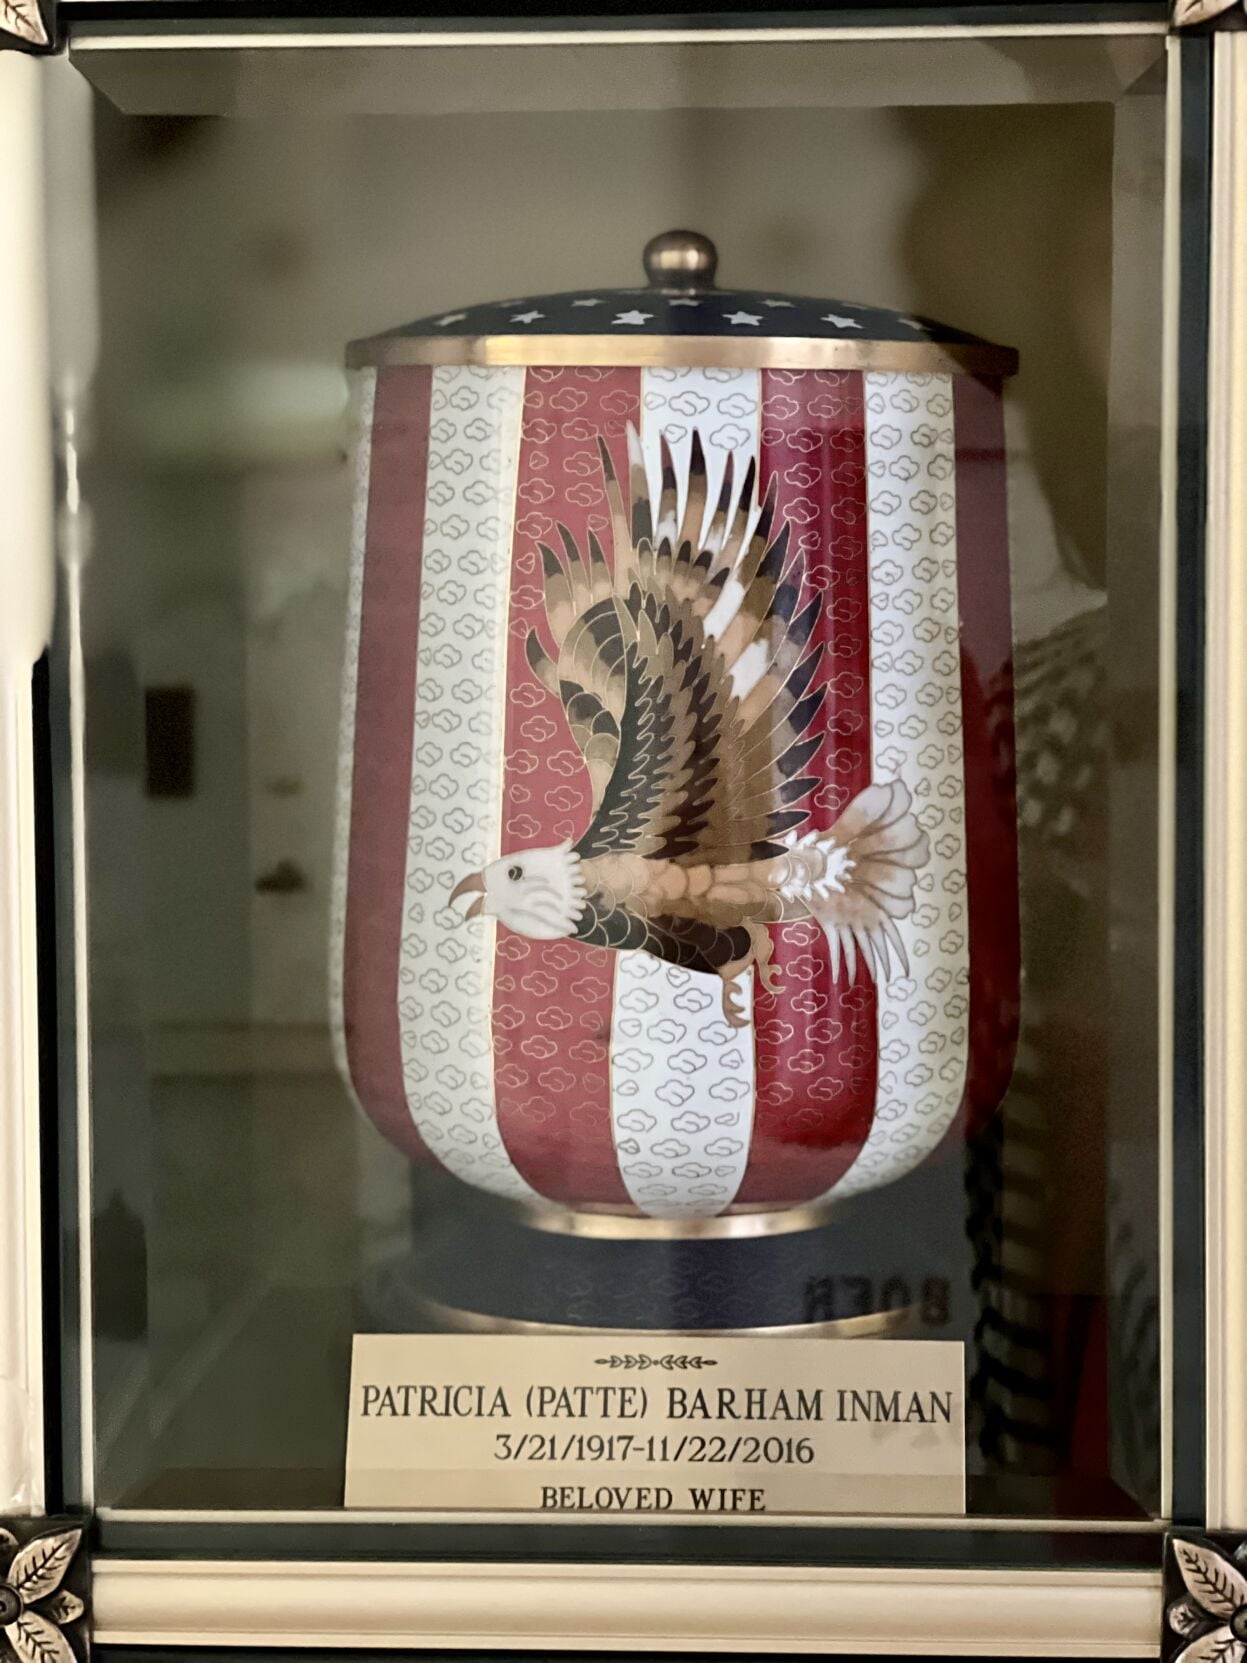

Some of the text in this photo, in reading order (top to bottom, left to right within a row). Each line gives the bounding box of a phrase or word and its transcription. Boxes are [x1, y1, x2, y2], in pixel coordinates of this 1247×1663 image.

[361, 1385, 953, 1424] PATRICIA (PATTE) BARHAM INMAN
[494, 1433, 816, 1465] 3/21/1917-11/22/2016
[541, 1486, 767, 1512] BELOVED WIFE
